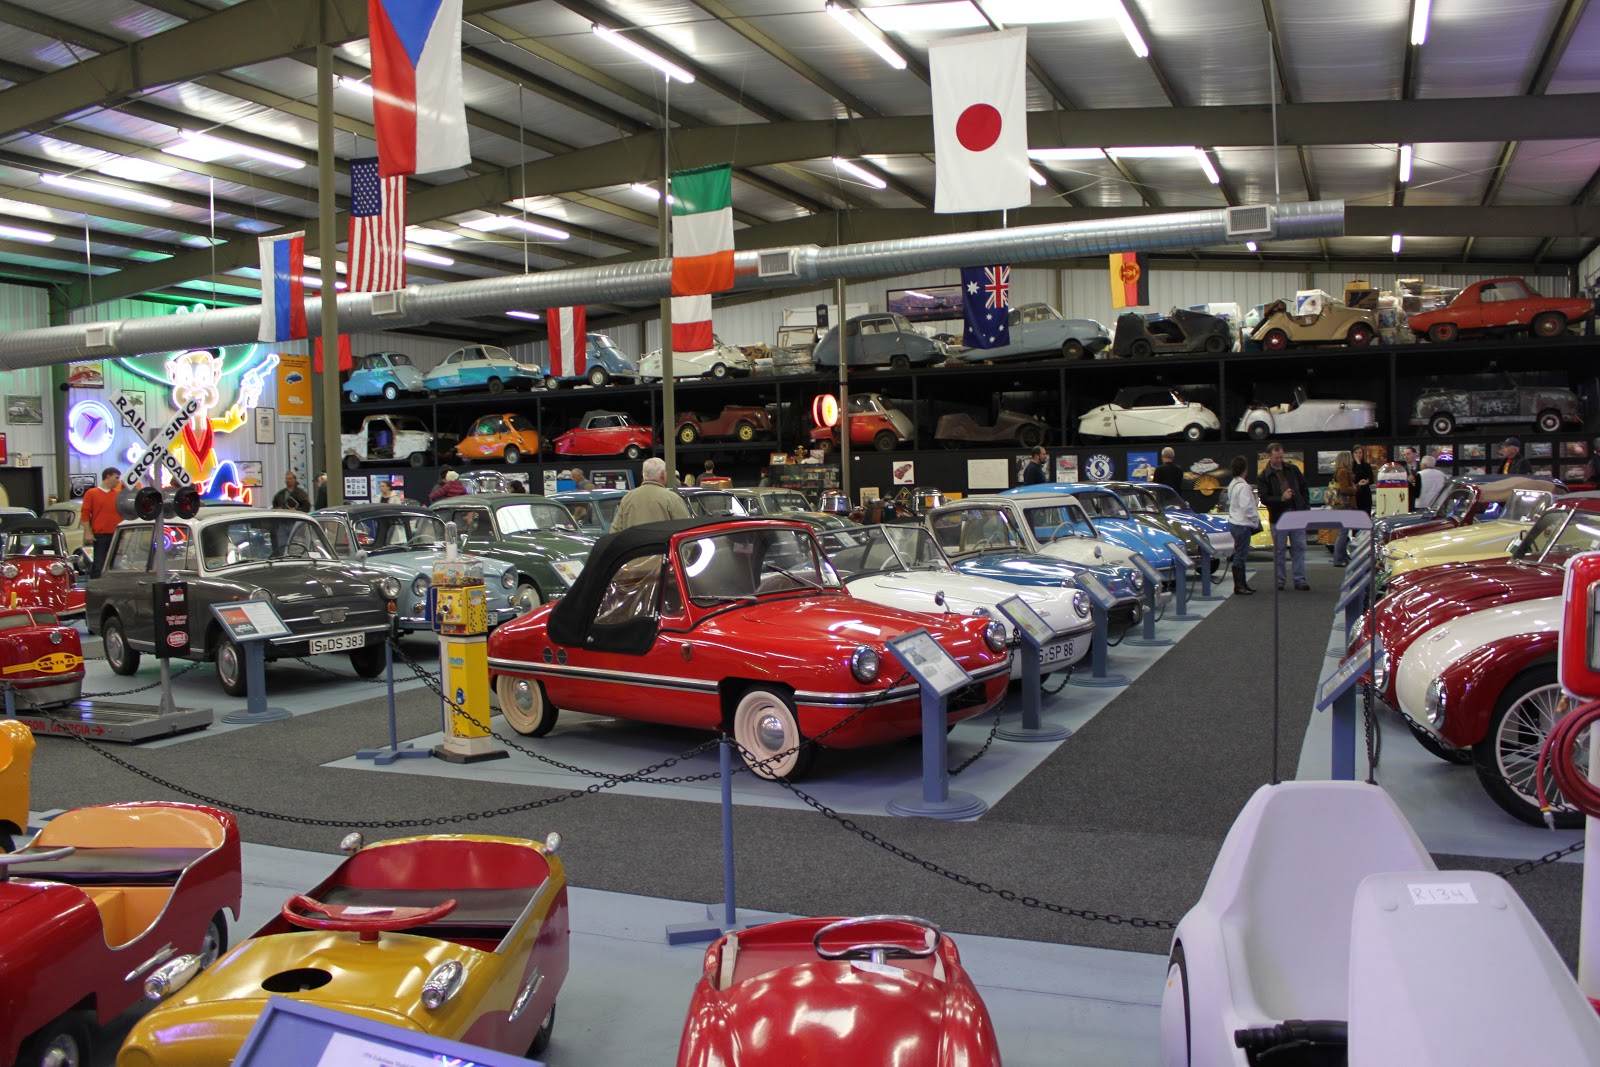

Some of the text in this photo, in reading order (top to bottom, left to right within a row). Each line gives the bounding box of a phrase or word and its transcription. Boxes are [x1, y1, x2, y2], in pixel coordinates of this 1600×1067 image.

[116, 396, 146, 434] RAIL
[345, 634, 364, 648] 383
[37, 660, 65, 668] SANTA
